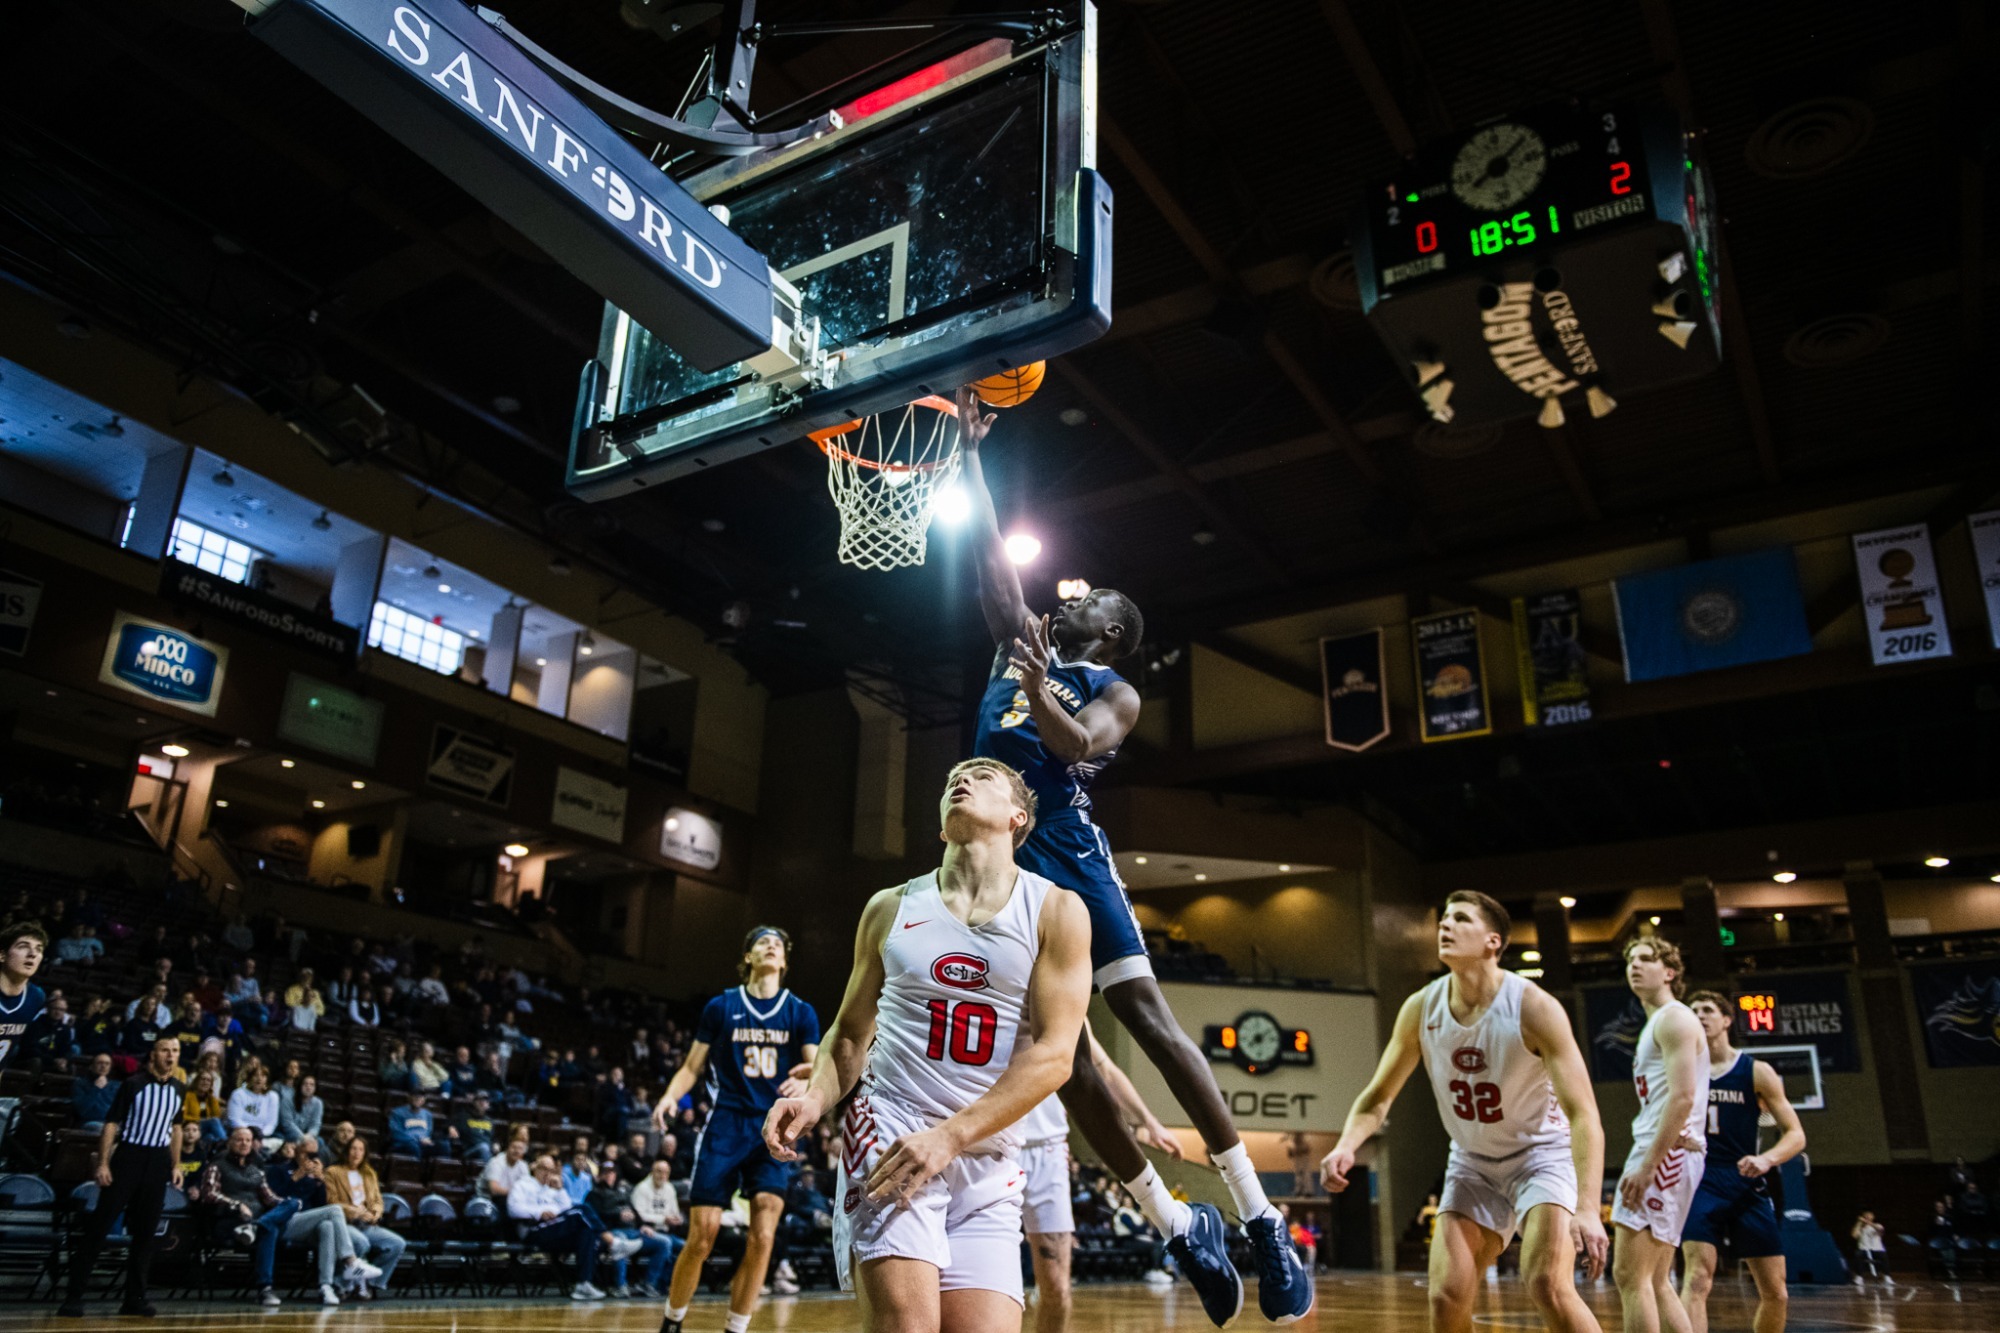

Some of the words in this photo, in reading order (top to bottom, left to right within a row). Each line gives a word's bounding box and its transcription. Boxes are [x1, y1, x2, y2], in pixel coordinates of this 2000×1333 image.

[1602, 113, 1617, 132] 3
[1606, 137, 1620, 155] 4
[1610, 161, 1631, 195] 2
[1386, 183, 1397, 201] 1
[1387, 206, 1400, 225] 2
[1574, 194, 1645, 229] VISITOR
[1415, 220, 1438, 253] 0
[1882, 630, 1938, 657] 2016
[134, 653, 197, 687] MIDCO
[1544, 701, 1592, 727] 2016
[1748, 1009, 1775, 1031] 14
[1781, 1017, 1843, 1035] KINGS
[732, 1027, 790, 1045] AUGUSTANA
[926, 999, 998, 1066] 10
[1221, 1027, 1237, 1049] 0
[1294, 1030, 1309, 1052] 2
[743, 1045, 778, 1079] 30
[1449, 1079, 1504, 1124] 32
